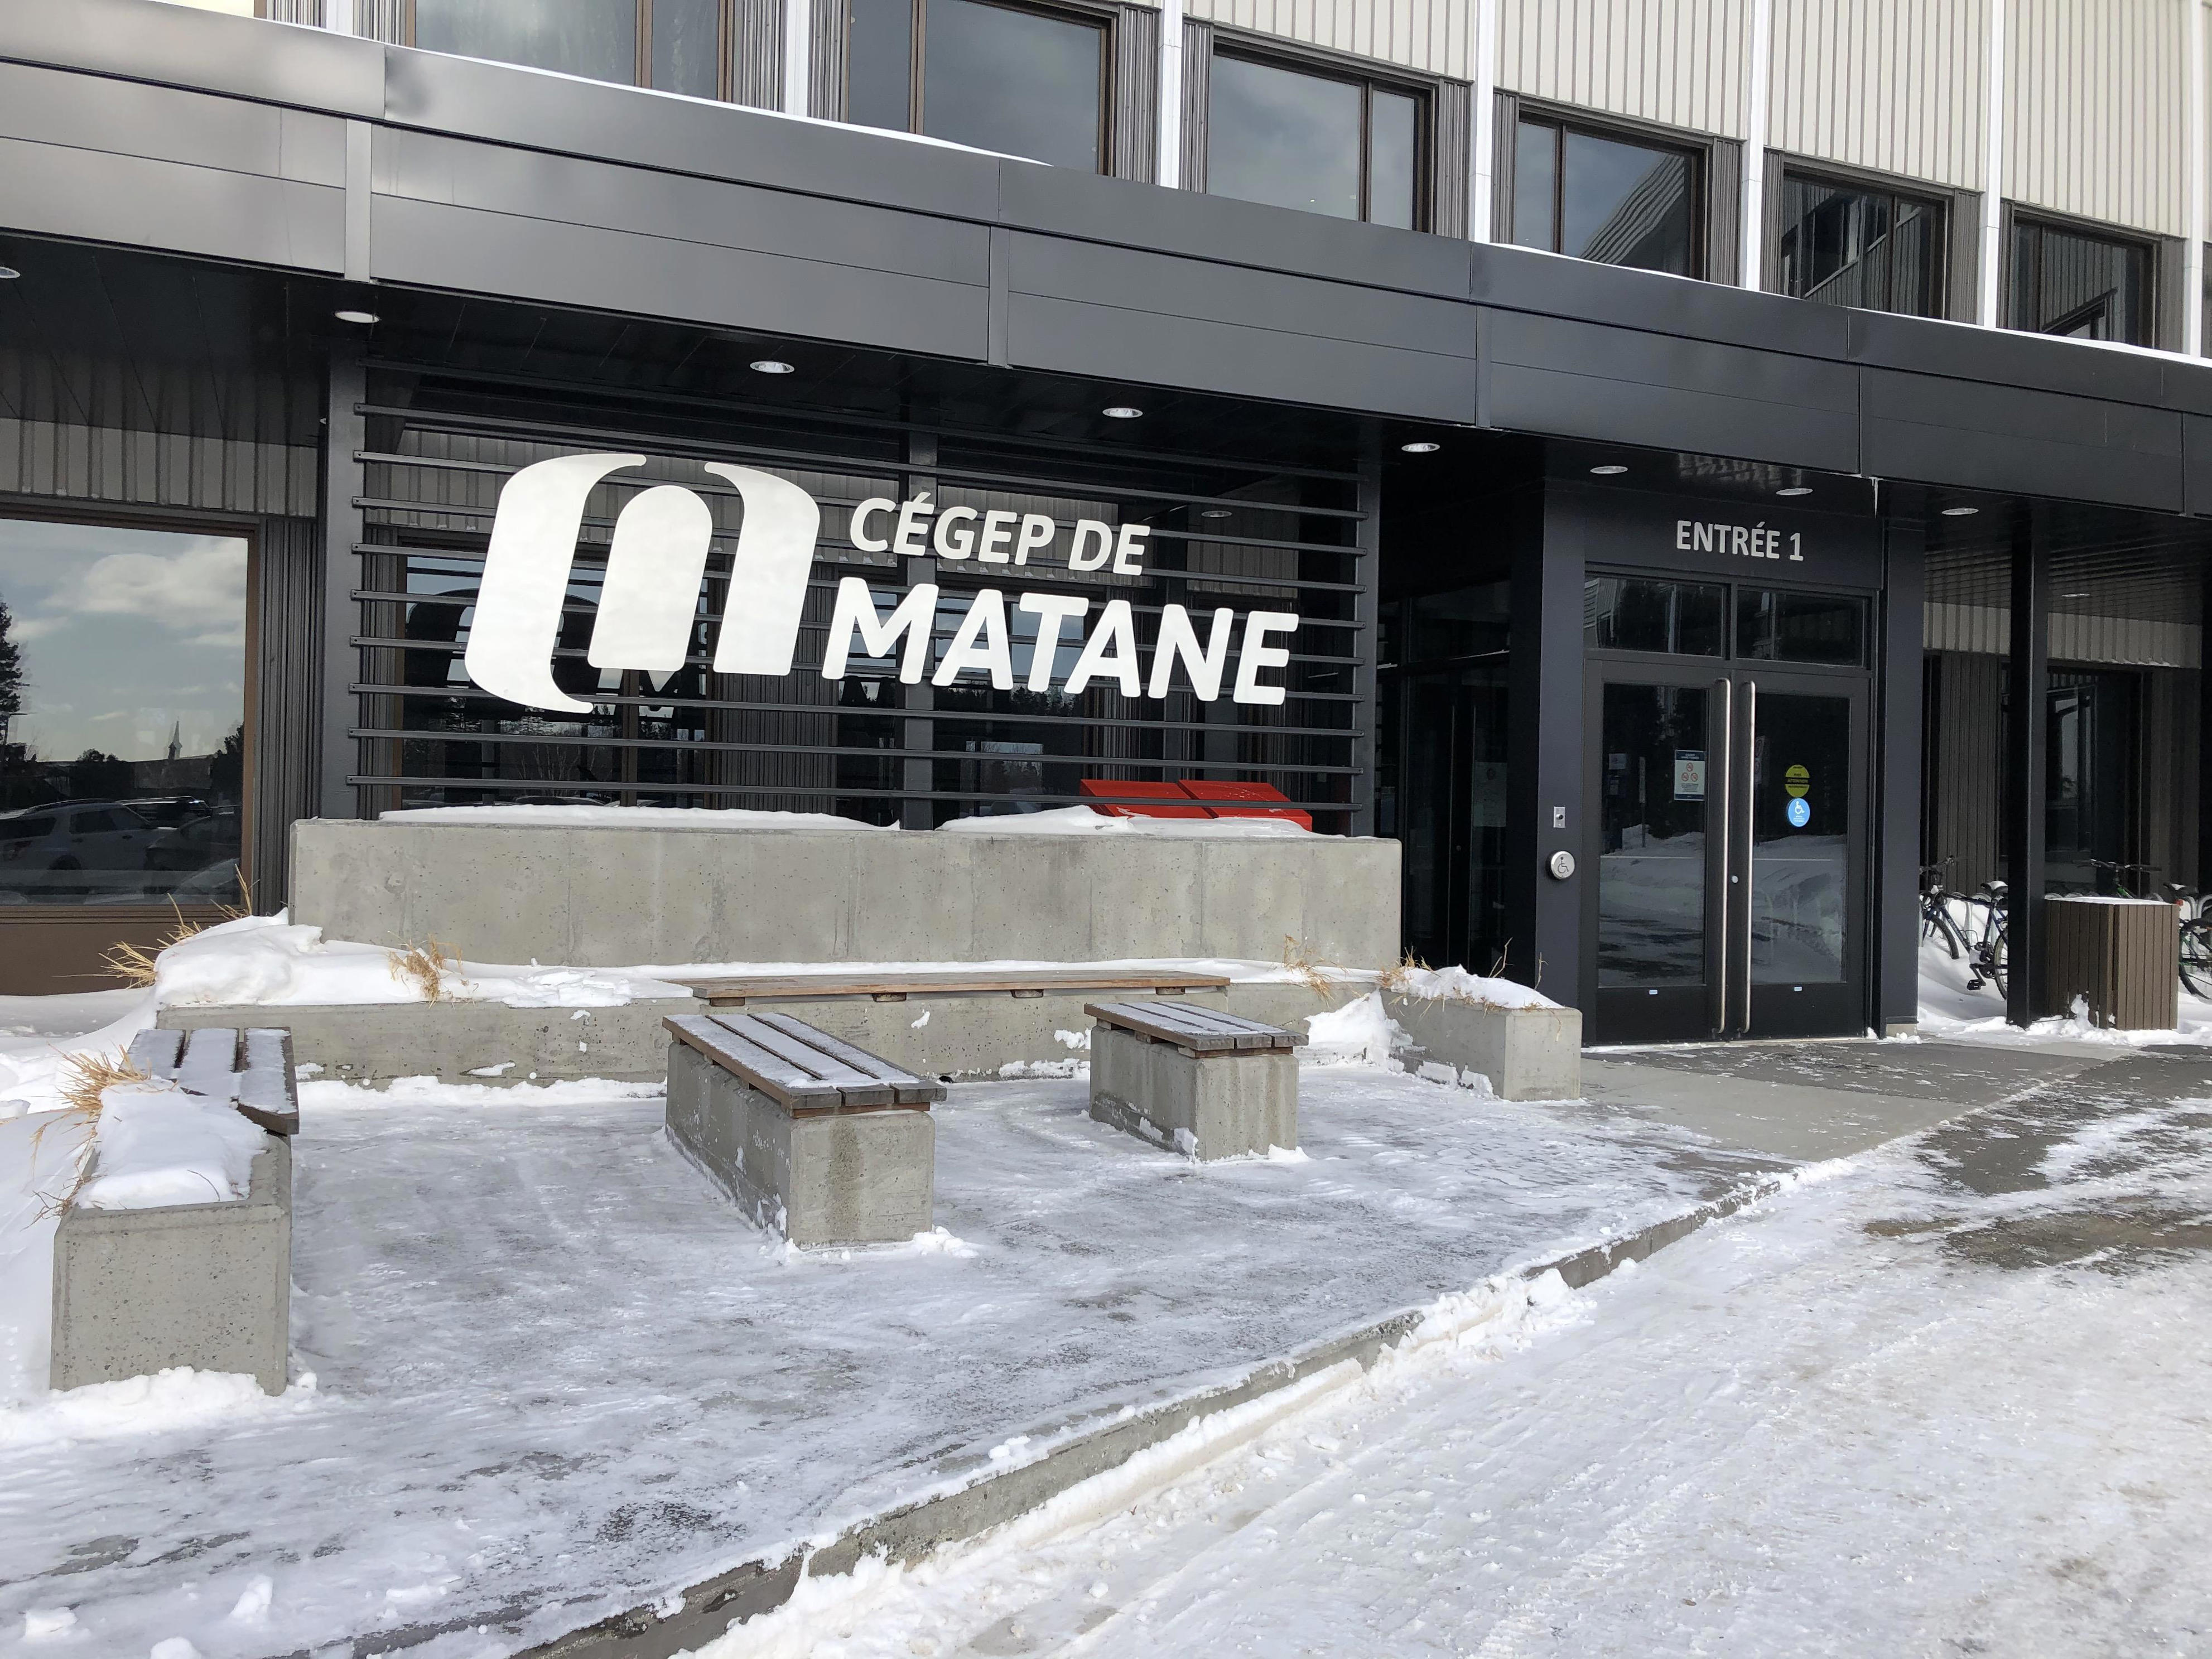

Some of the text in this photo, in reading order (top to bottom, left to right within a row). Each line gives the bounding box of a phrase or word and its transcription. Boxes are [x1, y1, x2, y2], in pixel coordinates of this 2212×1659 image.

[850, 491, 1151, 576] CÉGEP DE
[1676, 520, 1804, 561] ENTRÉE 1
[821, 576, 1299, 706] MATANE
